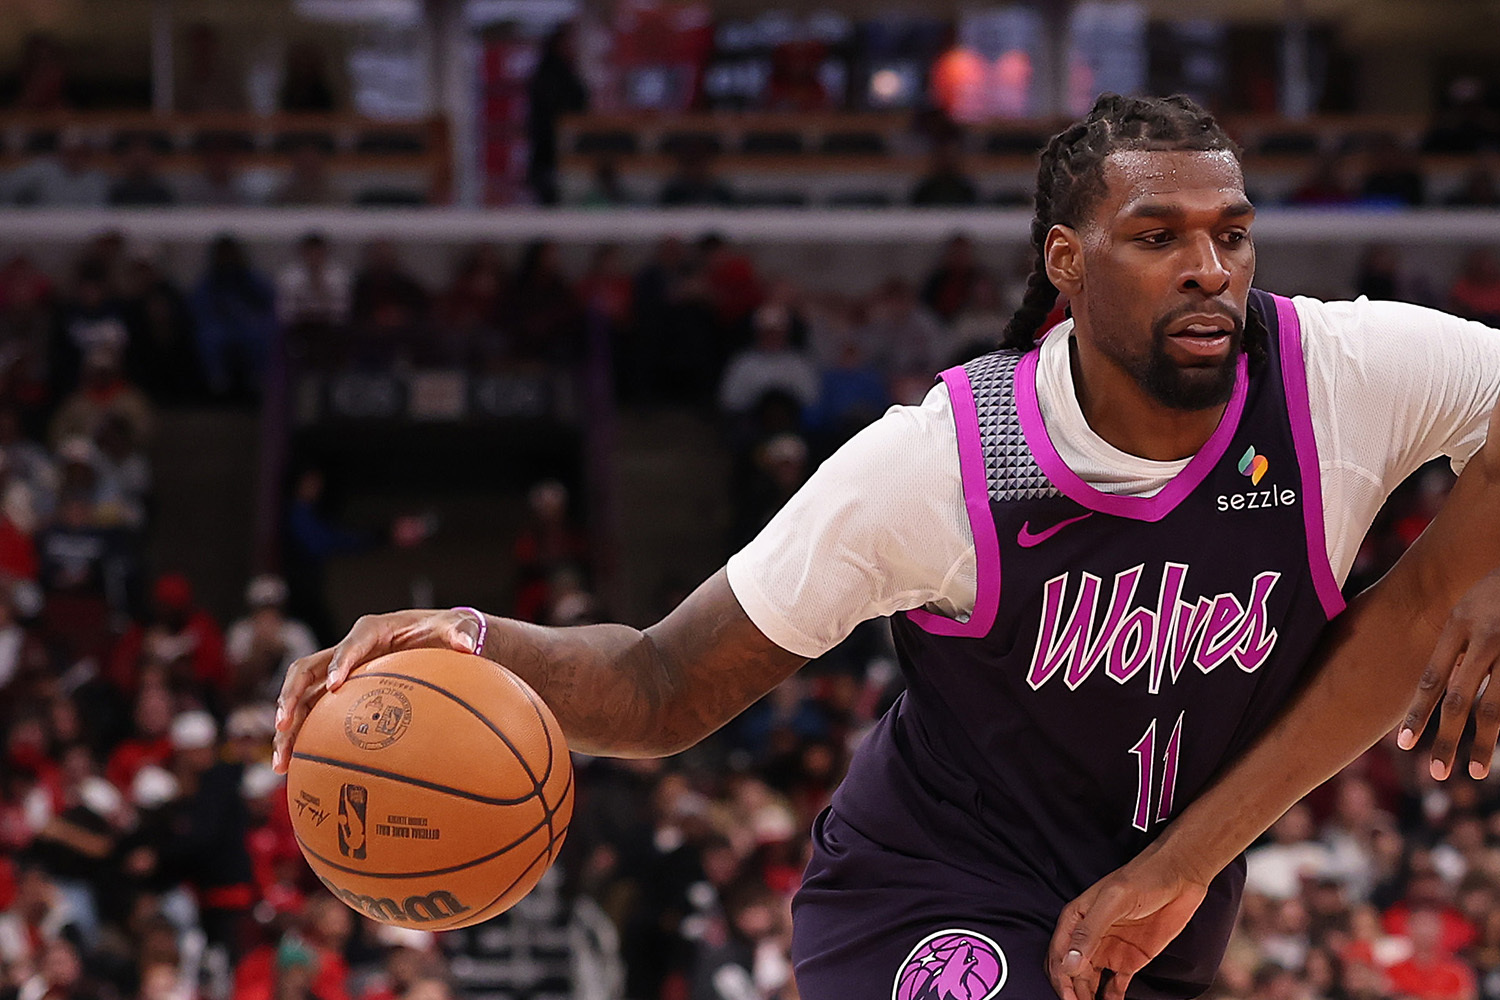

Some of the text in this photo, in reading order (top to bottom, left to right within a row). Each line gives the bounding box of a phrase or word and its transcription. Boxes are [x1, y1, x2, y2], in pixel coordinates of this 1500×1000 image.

[1217, 484, 1296, 511] sezzle
[1026, 562, 1281, 694] Wolves
[1128, 710, 1185, 832] 11
